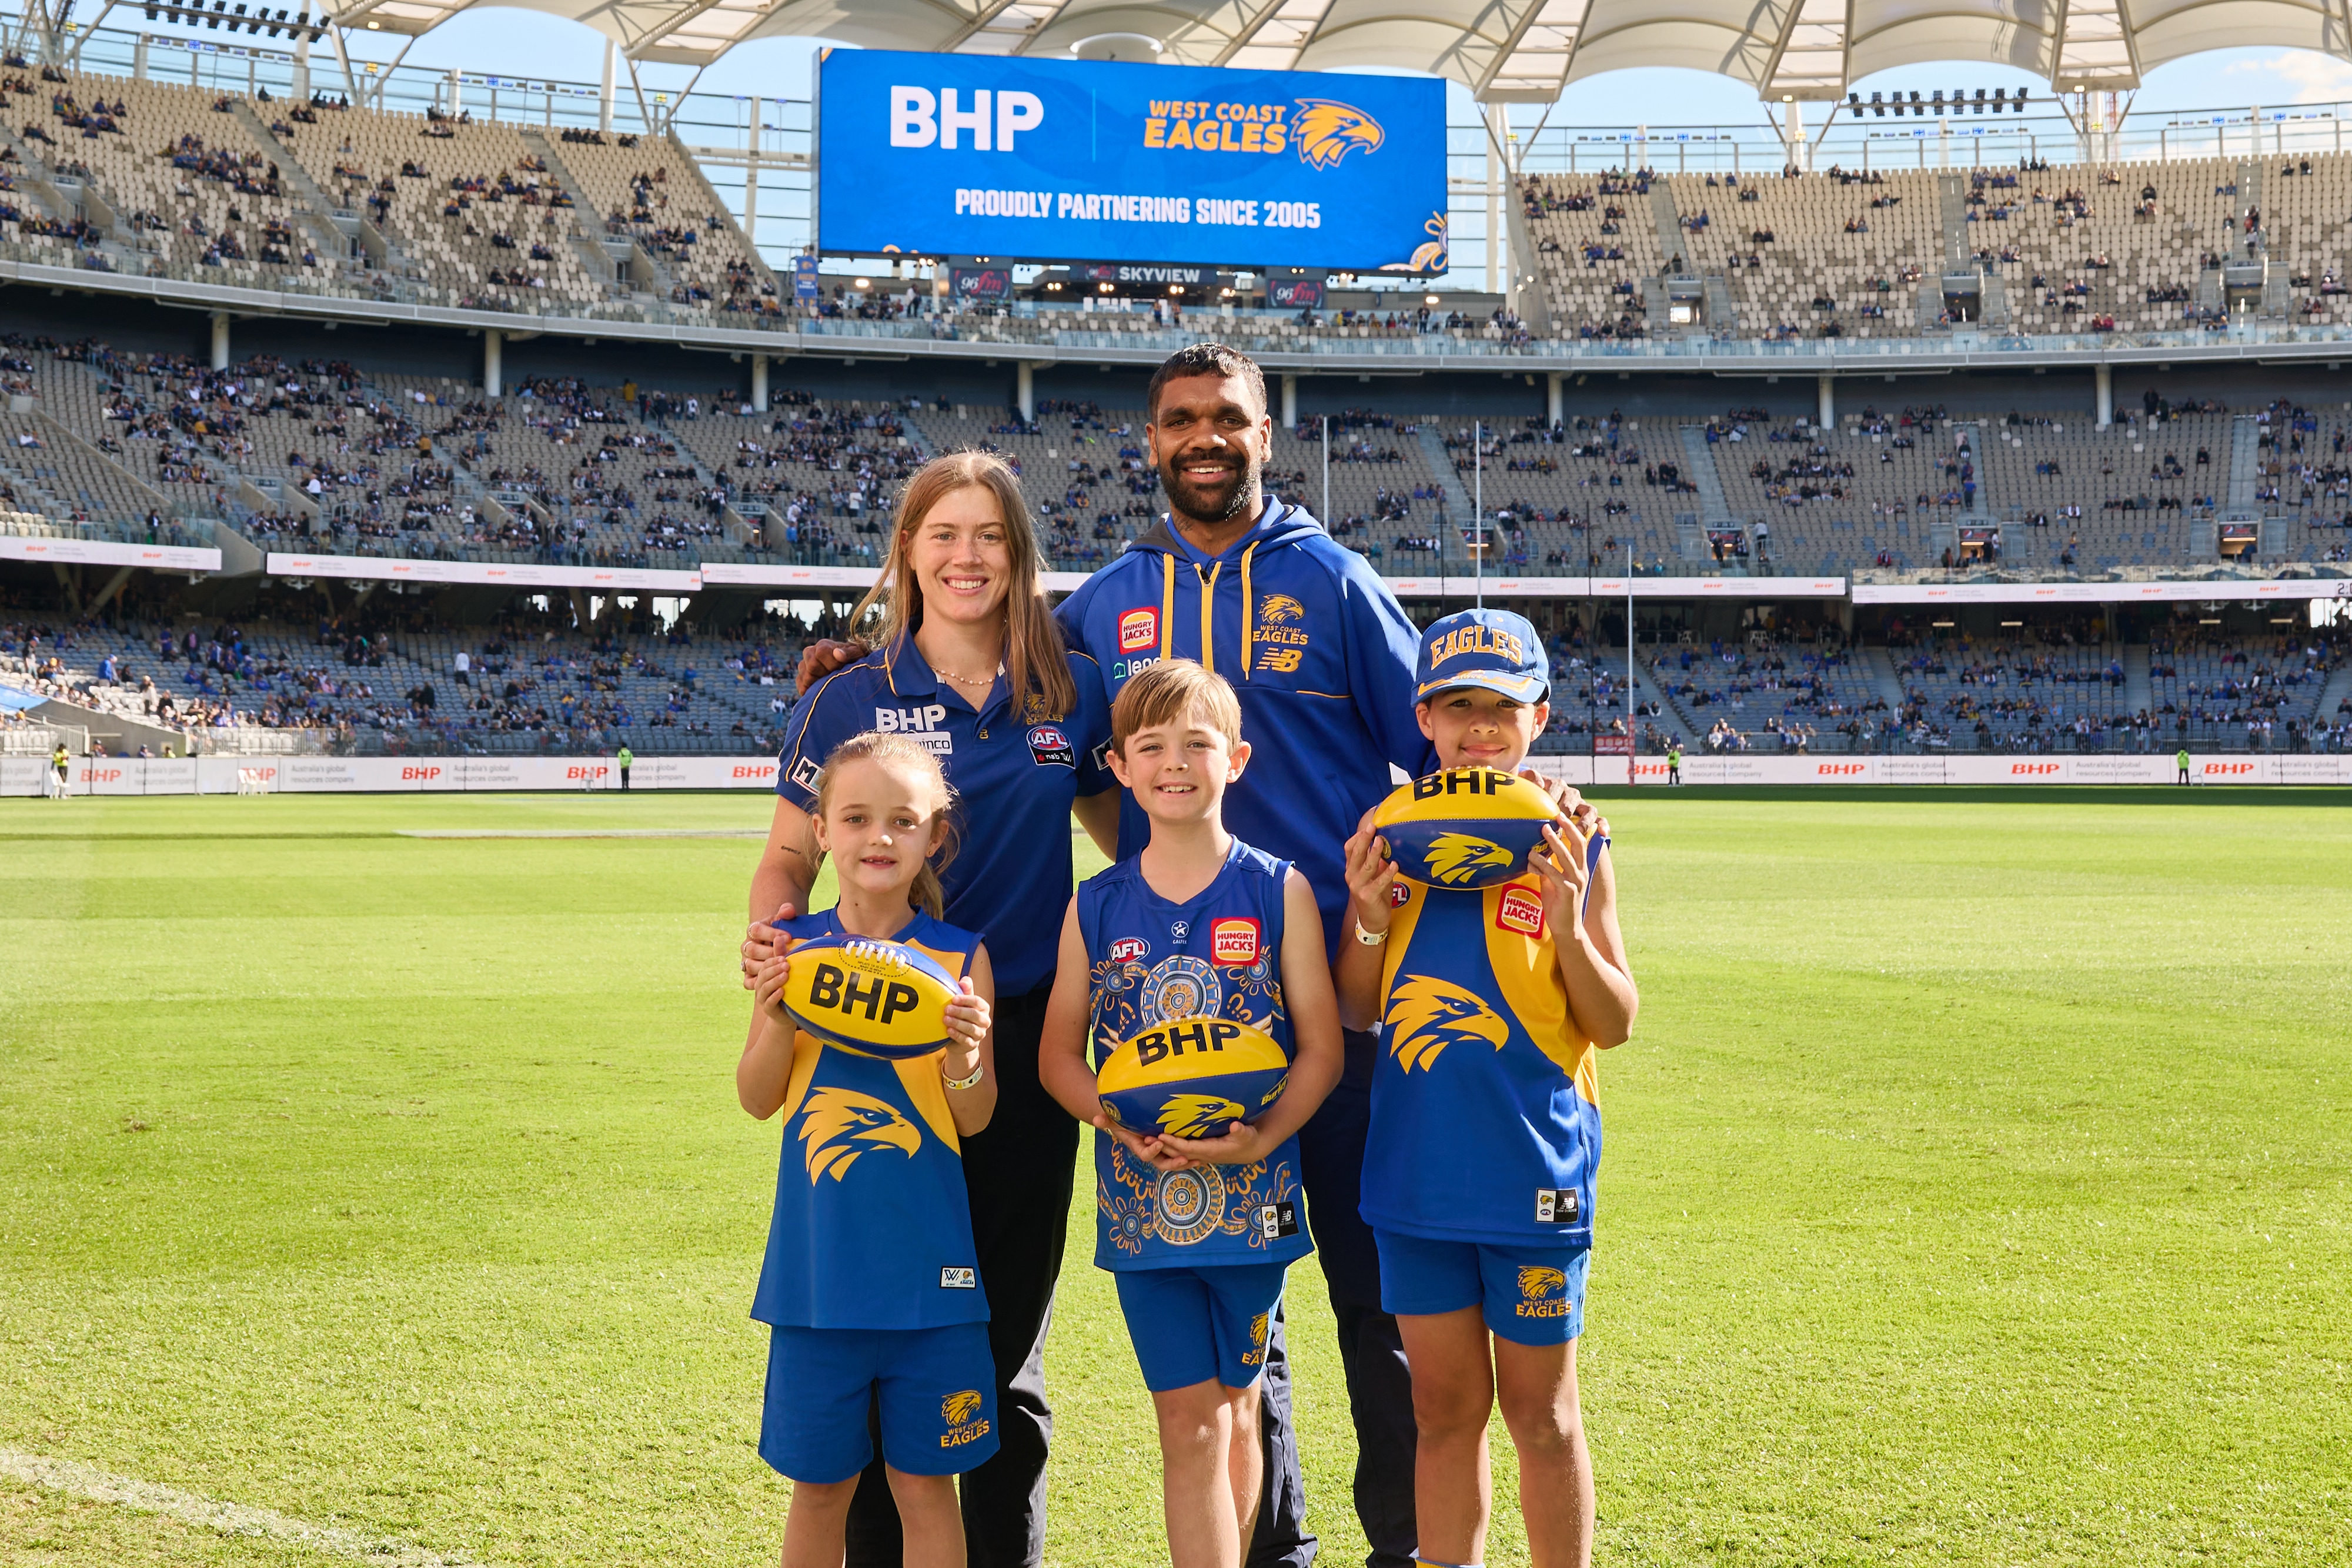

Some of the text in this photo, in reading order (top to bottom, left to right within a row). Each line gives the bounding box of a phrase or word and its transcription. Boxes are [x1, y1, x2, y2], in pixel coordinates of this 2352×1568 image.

[1149, 99, 1287, 123] WEST COAST
[890, 85, 1044, 152] BHP
[1143, 118, 1288, 154] EAGLES
[956, 188, 1321, 229] PROUDLY PARTNERING SINCE 2005
[1119, 266, 1200, 283] SKYVIEW
[1123, 620, 1152, 632] HUNGRY
[1252, 630, 1309, 645] EAGLES
[1431, 624, 1523, 671] EAGLES
[876, 704, 946, 732] BHP
[1033, 732, 1068, 746] AFL
[326, 764, 346, 774] global
[489, 764, 510, 773] global
[656, 764, 677, 773] global
[732, 765, 775, 778] BHP
[1818, 764, 1865, 775] BHP
[2011, 763, 2060, 775] BHP
[2204, 763, 2254, 774] BHP
[2314, 761, 2339, 769] global
[81, 769, 121, 782] BHP
[402, 767, 441, 780] BHP
[566, 766, 609, 779] BHP
[1414, 770, 1515, 801] BHP
[1506, 897, 1540, 915] HUNGRY
[1217, 932, 1254, 941] HUNGRY
[1111, 942, 1145, 961] AFL
[809, 962, 919, 1025] BHP
[1137, 1023, 1240, 1067] BHP
[1516, 1300, 1572, 1317] EAGLES
[1545, 1297, 1565, 1306] COAST
[940, 1420, 990, 1448] EAGLES
[948, 1426, 967, 1436] WEST
